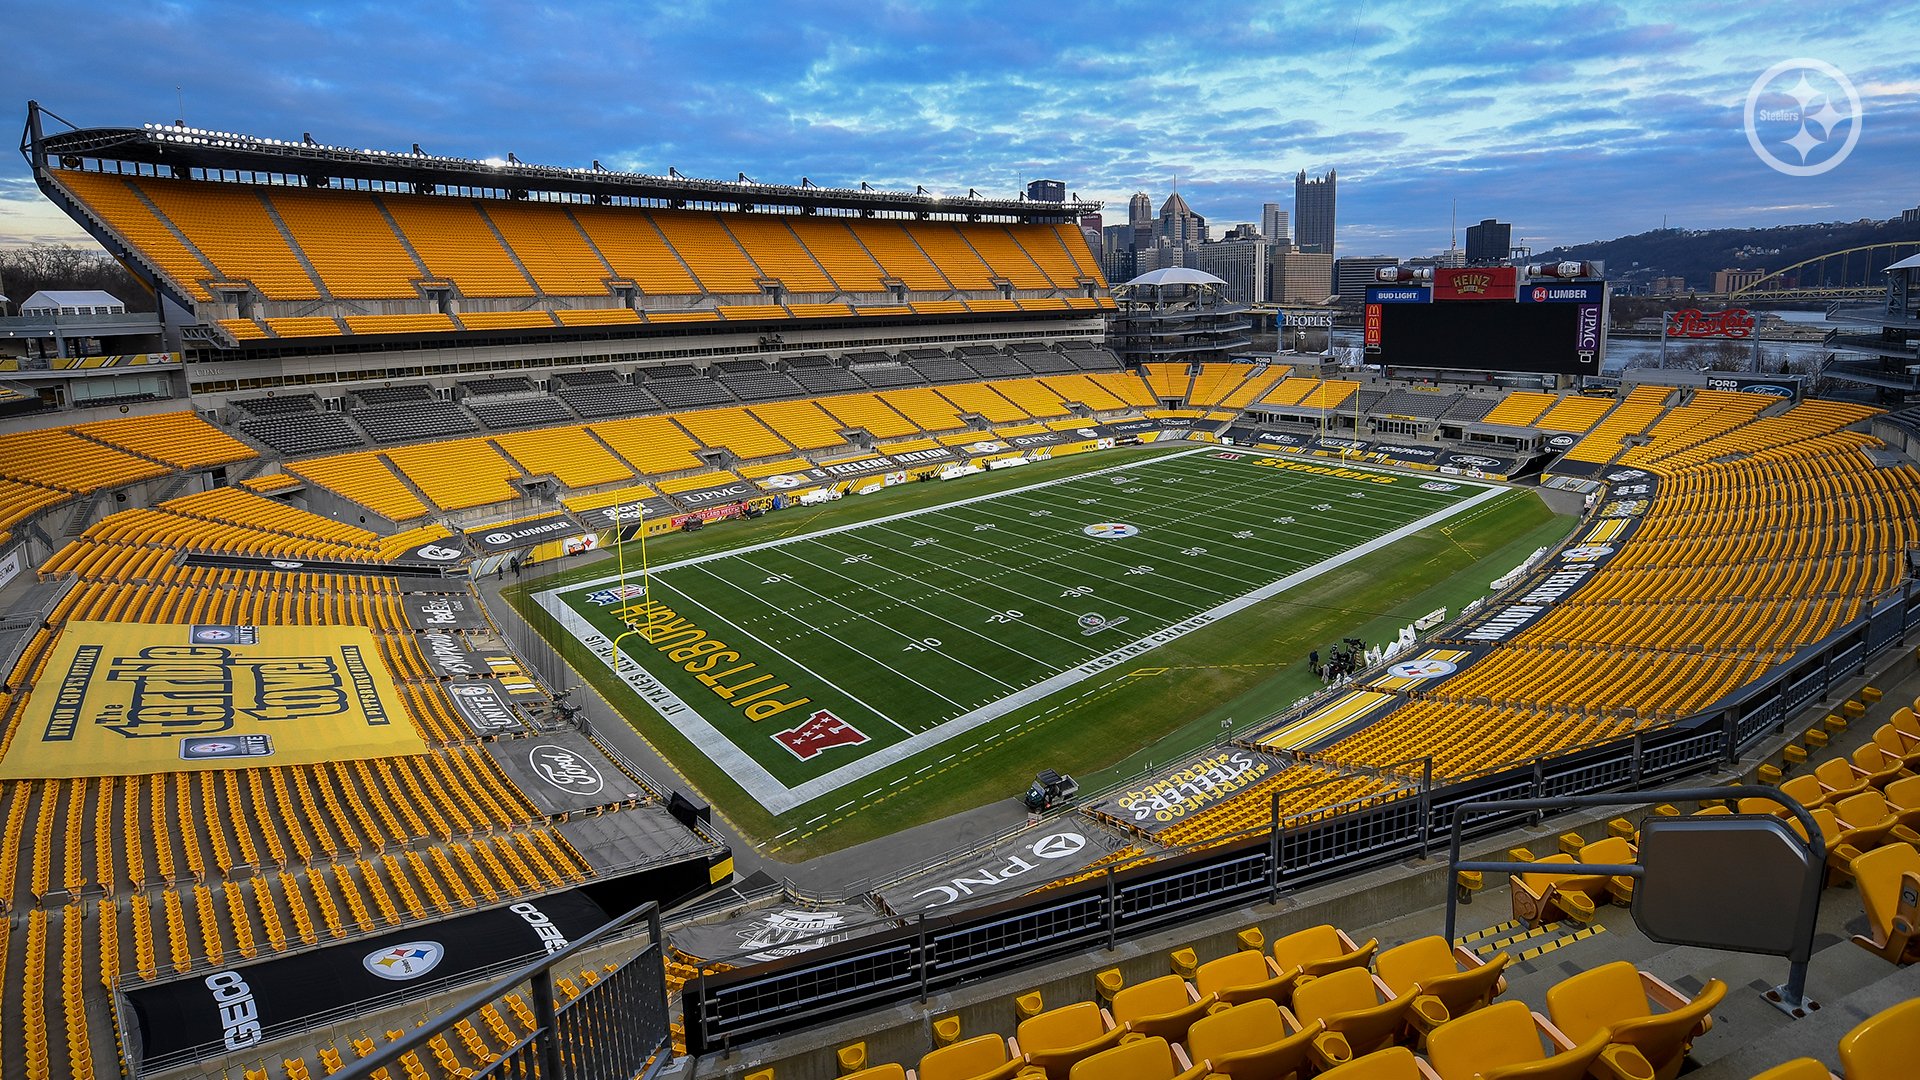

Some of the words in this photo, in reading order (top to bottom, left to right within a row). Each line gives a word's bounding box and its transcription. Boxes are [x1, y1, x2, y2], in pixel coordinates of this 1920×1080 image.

[1453, 274, 1490, 287] HEINZ
[1549, 290, 1587, 298] LUMBER
[1285, 315, 1332, 327] PEOPLES
[1583, 307, 1598, 348] UPMC
[1708, 379, 1738, 387] FORD
[1031, 434, 1060, 444] PNC
[811, 456, 893, 478] STEELERS
[894, 448, 951, 464] NATION
[1252, 457, 1398, 484] Steelers
[684, 486, 747, 502] UPMC
[512, 522, 571, 538] LUMBER
[1181, 546, 1208, 556] 50
[1069, 584, 1094, 598] 30
[994, 608, 1024, 624] 20
[584, 635, 606, 646] US
[596, 647, 618, 658] OF
[1078, 642, 1152, 674] INSPIRE
[1151, 614, 1215, 642] CHANGE
[610, 600, 813, 723] PITTSBURGH
[610, 656, 638, 673] ALL
[352, 672, 382, 716] PITTSBURGH
[628, 673, 670, 703] TAKES
[48, 708, 76, 736] MYRON
[474, 696, 512, 728] UNITE
[660, 703, 686, 716] IT
[540, 751, 598, 787] Ford
[1118, 753, 1229, 808] #HEREWEGO
[1128, 752, 1253, 820] STEELERS
[1155, 763, 1269, 822] #HEREWEGO
[912, 855, 1040, 909] PNC
[508, 902, 569, 955] GEICO
[785, 920, 824, 928] FIELD
[205, 971, 262, 1051] GEICO
